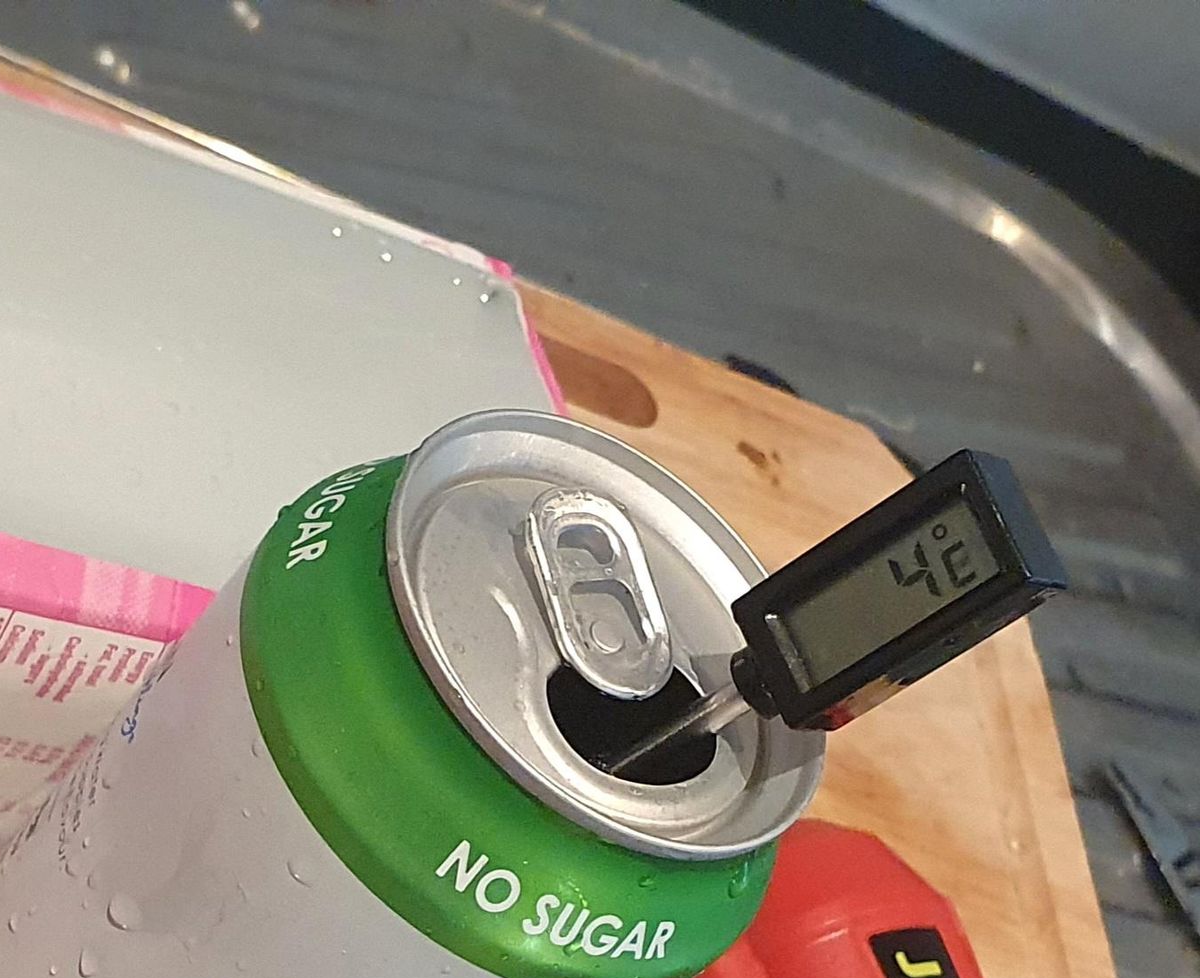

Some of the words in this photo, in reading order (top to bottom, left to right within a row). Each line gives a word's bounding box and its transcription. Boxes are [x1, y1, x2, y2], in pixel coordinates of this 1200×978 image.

[285, 466, 377, 570] SUGAR
[435, 839, 522, 914] NO
[522, 893, 677, 961] SUGAR
